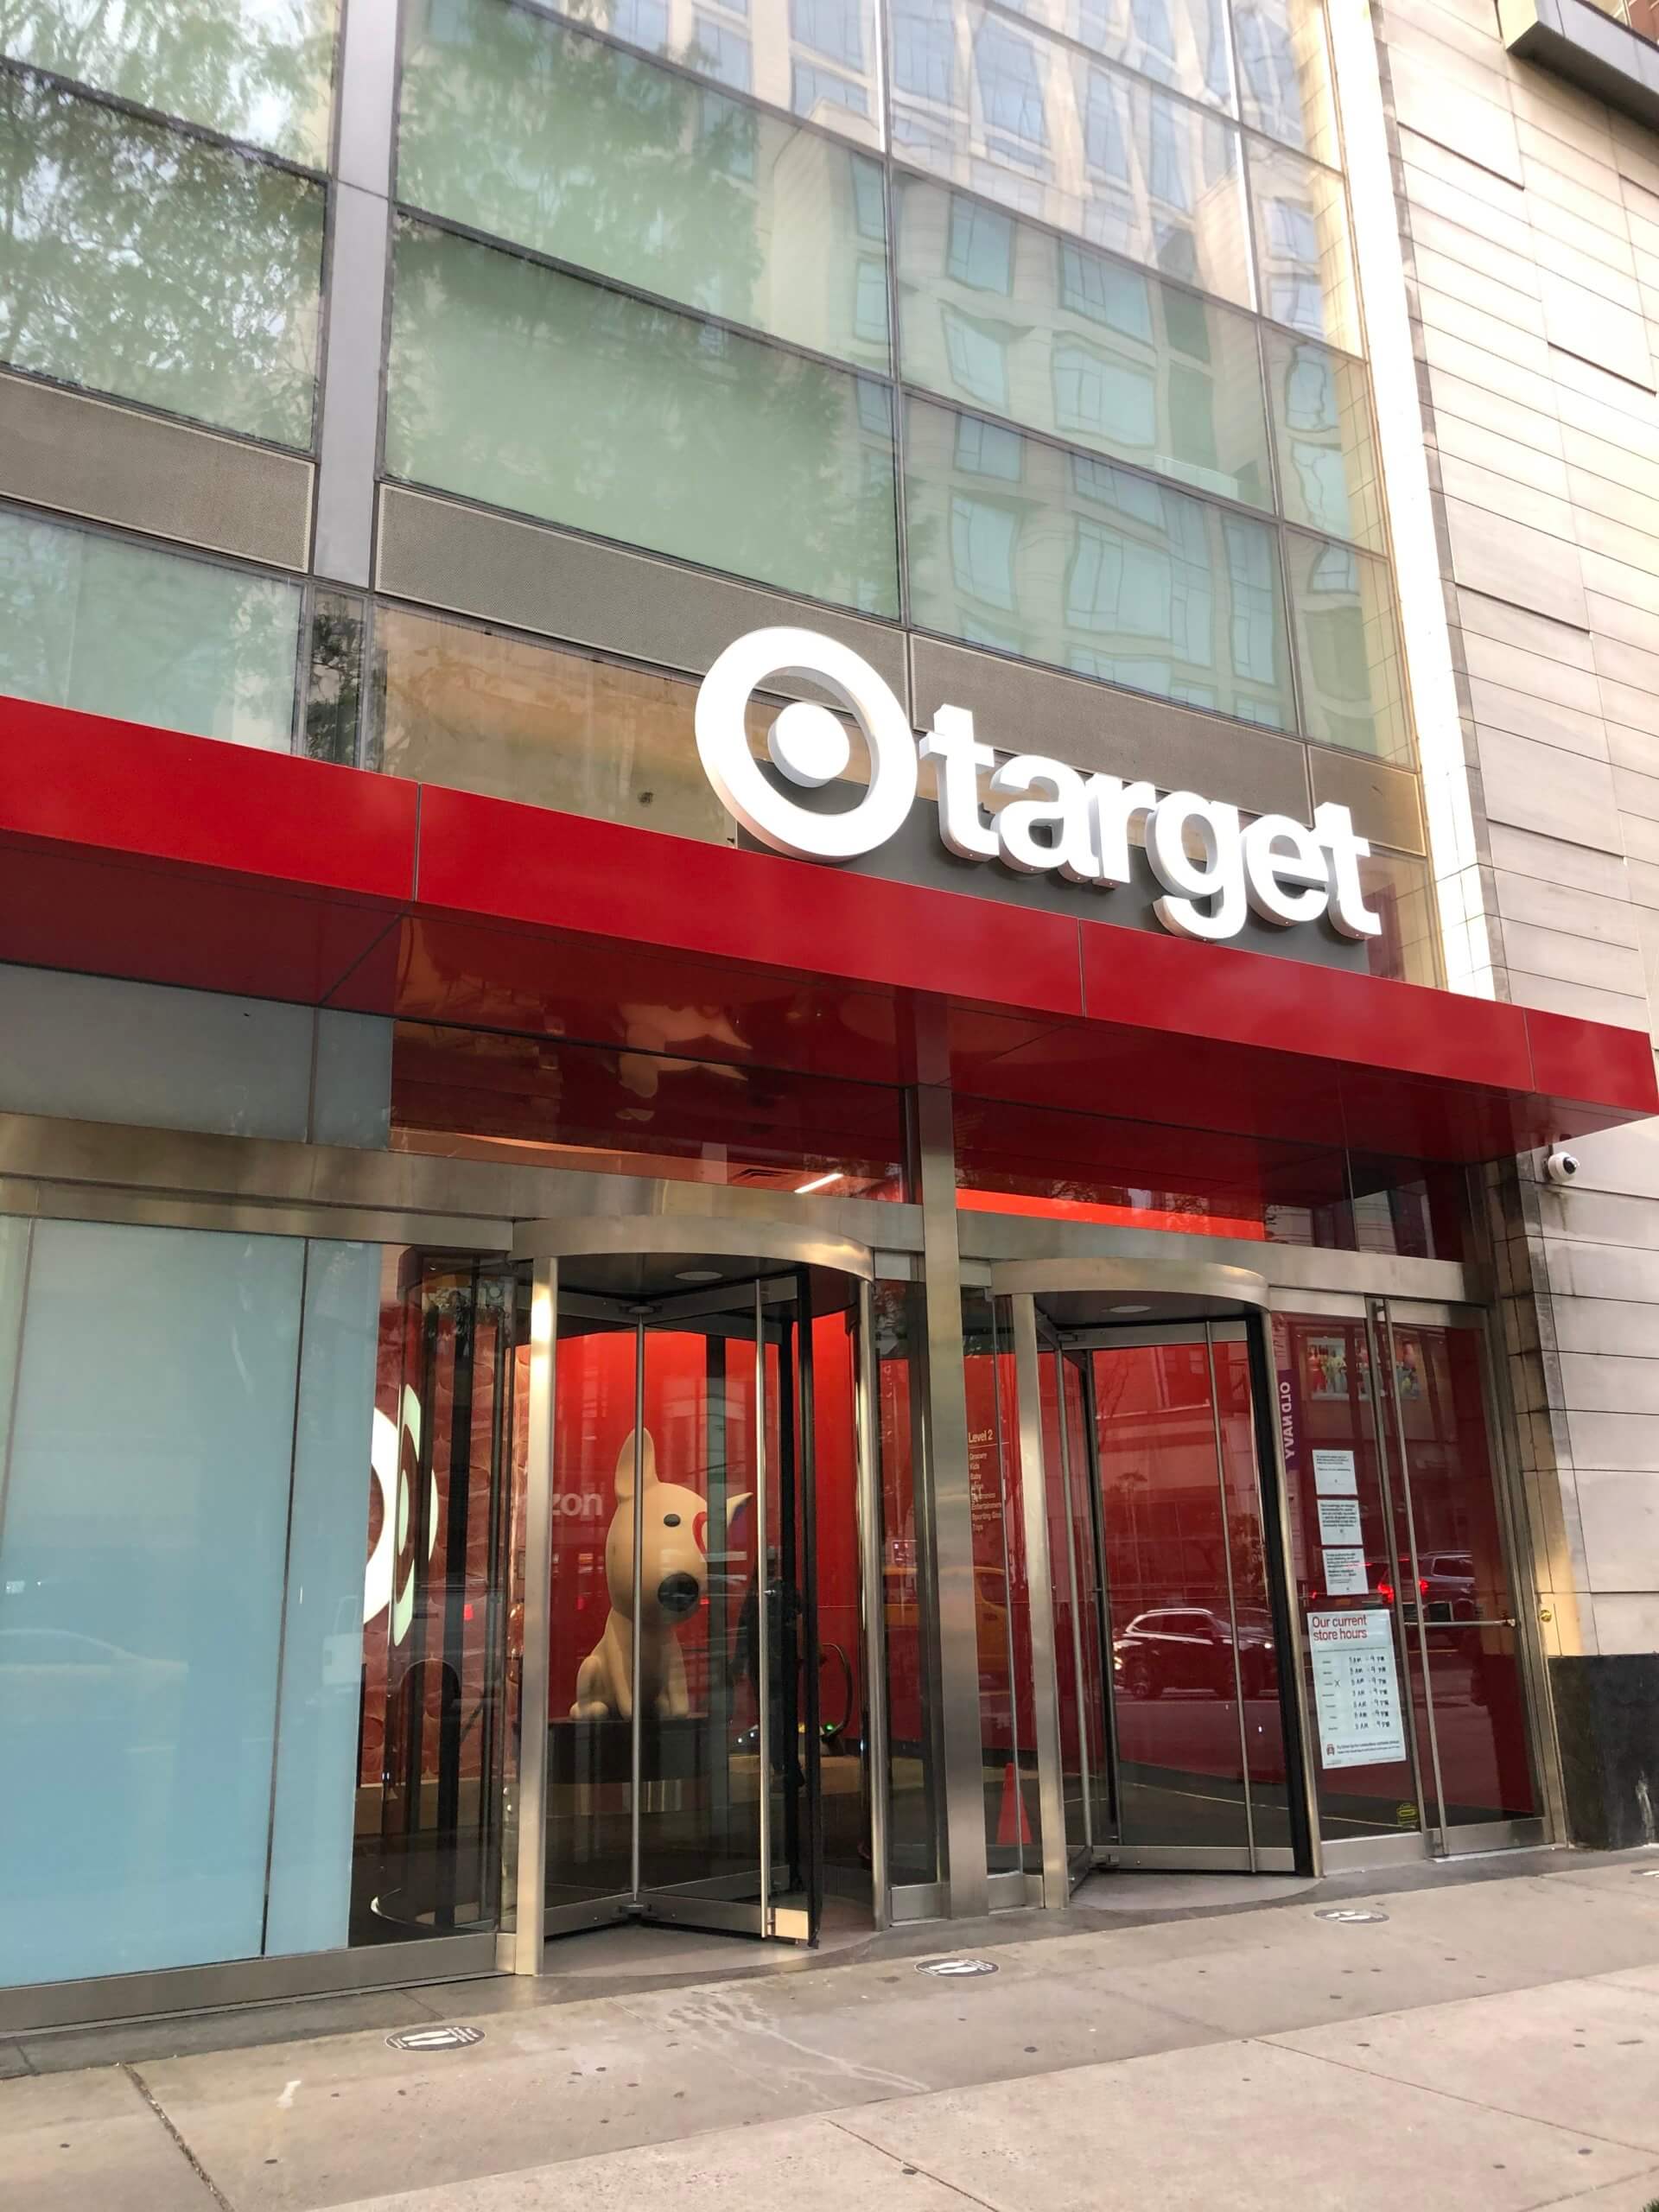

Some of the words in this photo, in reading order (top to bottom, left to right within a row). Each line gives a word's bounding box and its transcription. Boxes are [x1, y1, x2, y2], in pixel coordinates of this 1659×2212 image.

[919, 704, 1381, 942] target
[968, 1431, 987, 1443] Level
[988, 1429, 994, 1440] 2
[1312, 1616, 1330, 1628] Our
[1332, 1614, 1367, 1627] current
[1313, 1630, 1338, 1641] store
[1339, 1628, 1368, 1640] hours
